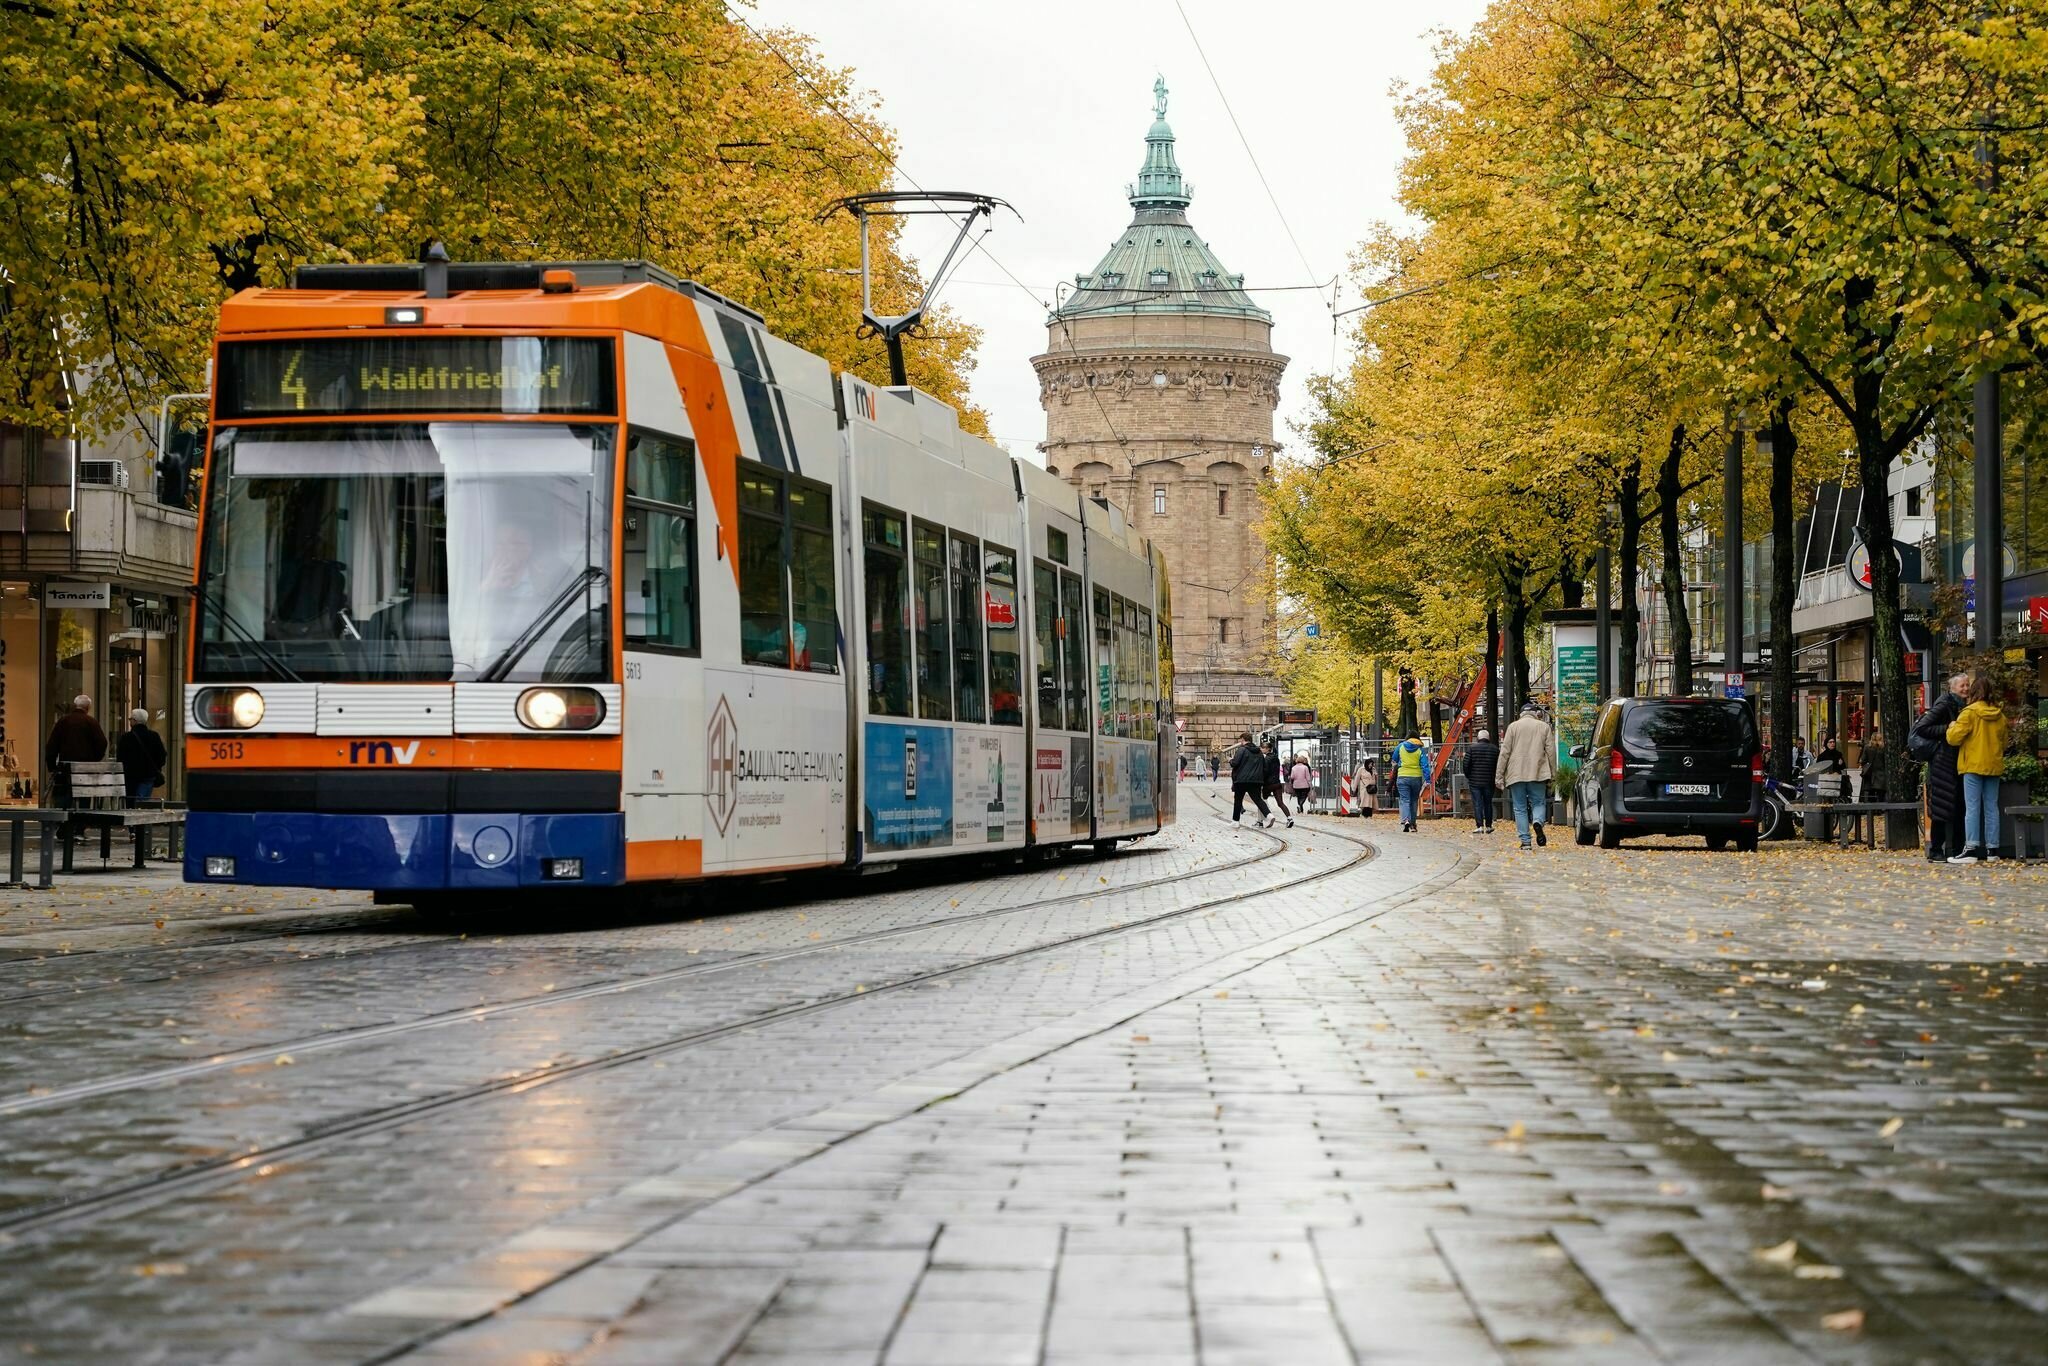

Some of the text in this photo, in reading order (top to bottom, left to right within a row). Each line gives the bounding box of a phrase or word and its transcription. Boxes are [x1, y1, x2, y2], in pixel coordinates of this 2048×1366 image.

[281, 350, 307, 410] 4
[853, 383, 876, 421] rnv
[626, 662, 642, 680] 5613
[210, 742, 244, 760] 5613
[349, 741, 420, 764] rnv
[738, 750, 844, 783] BAUUNTERNEHMUNG
[1690, 785, 1708, 793] 2431
